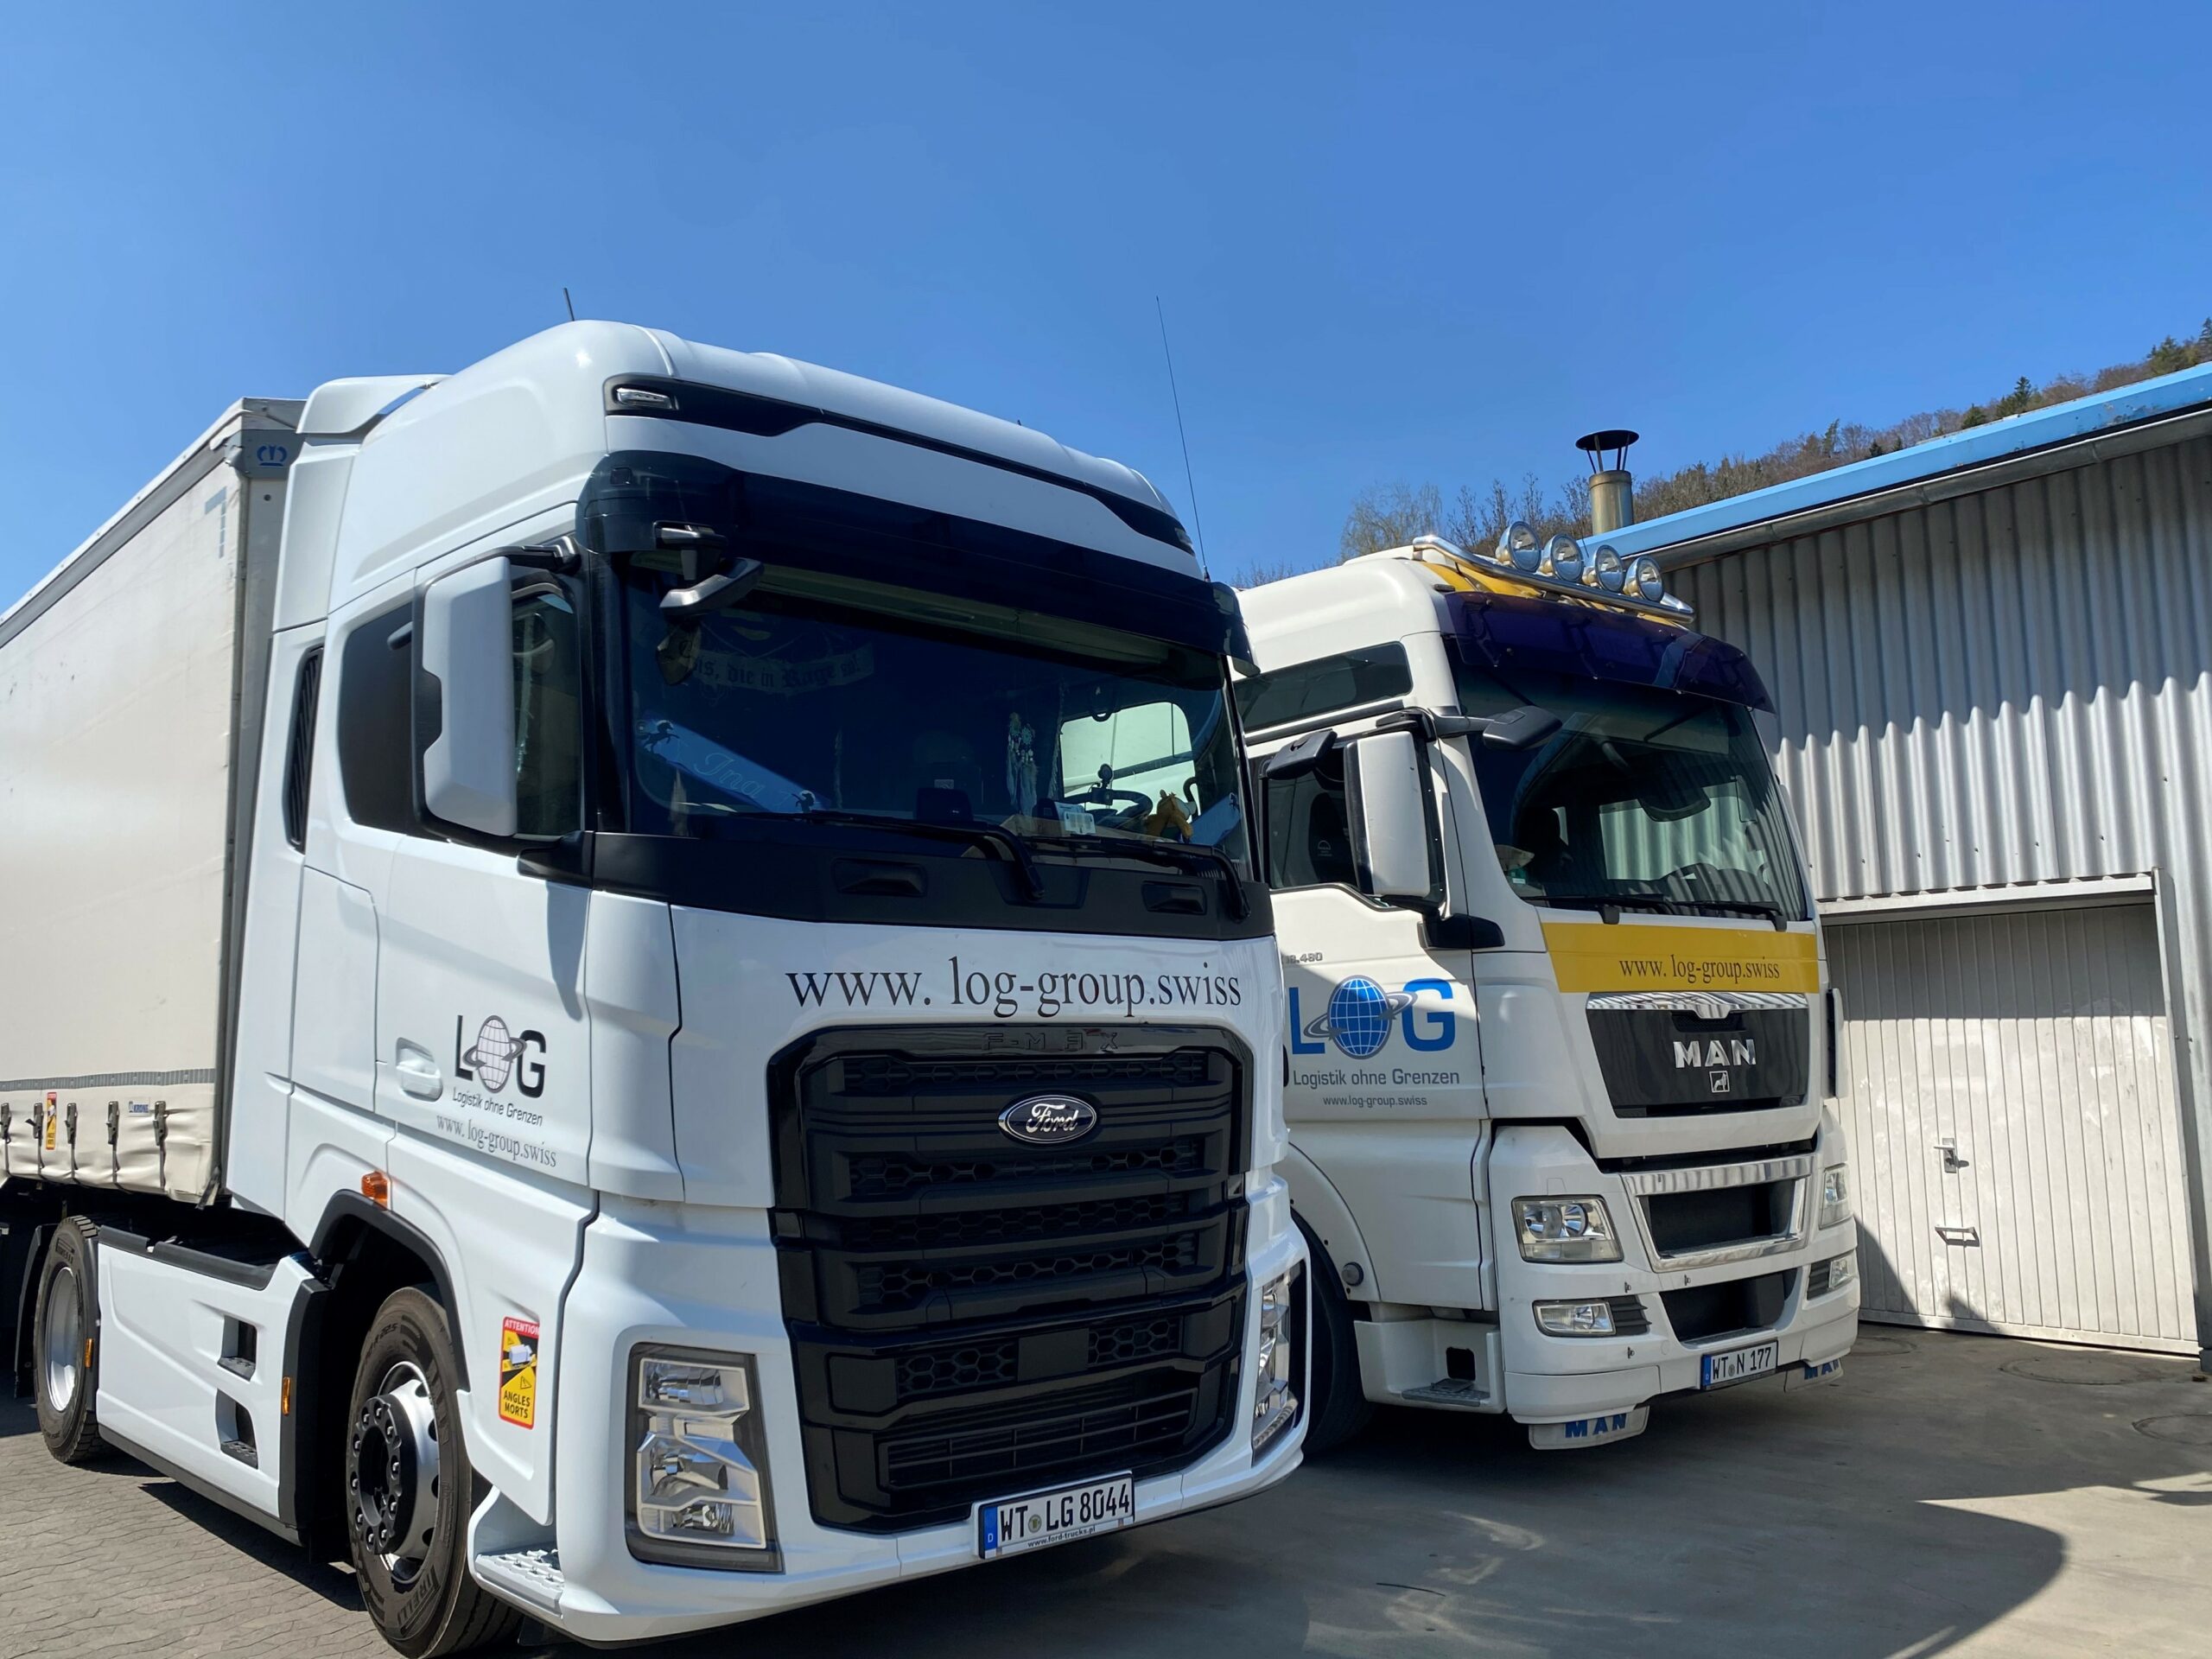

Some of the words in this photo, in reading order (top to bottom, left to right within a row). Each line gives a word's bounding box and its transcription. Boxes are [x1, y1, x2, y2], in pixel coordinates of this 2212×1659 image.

[727, 664, 753, 684] die
[760, 671, 774, 688] in
[1671, 954, 1780, 984] log-group.swiss
[785, 969, 933, 1008] www.
[949, 956, 1243, 1019] log-group.swiss
[1673, 1039, 1757, 1069] MAN
[1294, 1070, 1346, 1090] Logistik
[1351, 1070, 1387, 1086] ohne
[1392, 1068, 1459, 1085] Grenzen
[452, 1086, 483, 1108] Logistik
[484, 1098, 505, 1116] ohne
[506, 1103, 543, 1127] Grenzen
[1323, 1094, 1427, 1109] www.log-group.swiss
[1026, 1103, 1079, 1134] Ford
[467, 1118, 557, 1167] log-group.swiss
[1713, 1357, 1729, 1380] WT
[1737, 1352, 1745, 1375] N
[1750, 1346, 1771, 1371] 177
[504, 1390, 531, 1408] ANGLES
[505, 1402, 529, 1419] MORTS
[1565, 1413, 1627, 1438] MAN
[988, 1532, 994, 1543] D
[1000, 1505, 1028, 1541] WT
[1046, 1496, 1073, 1531] LG
[1080, 1484, 1130, 1523] 8044
[1027, 1526, 1096, 1548] www.ford-trucks.pl
